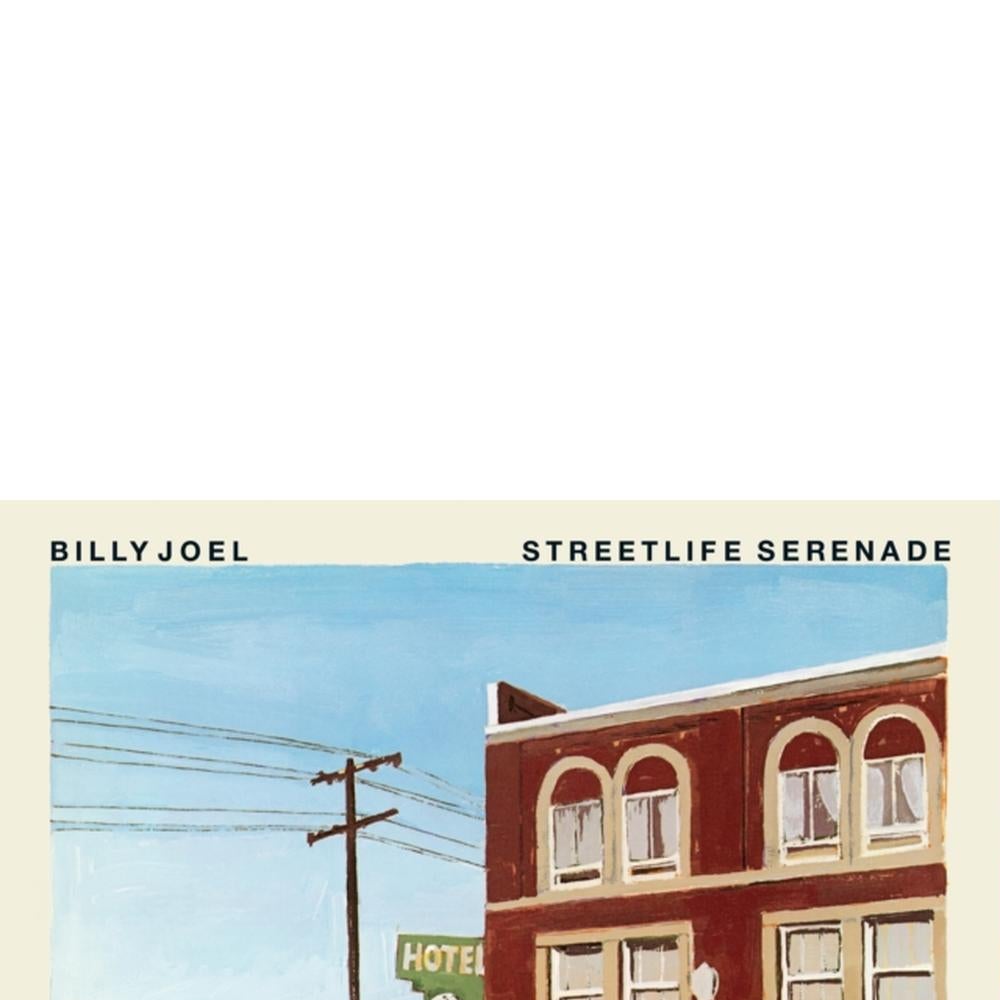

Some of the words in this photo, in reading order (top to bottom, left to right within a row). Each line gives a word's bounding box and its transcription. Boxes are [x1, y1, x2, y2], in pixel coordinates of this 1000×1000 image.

[51, 540, 148, 562] BILLY
[157, 540, 248, 562] JOEL
[522, 540, 741, 562] STREETLIFE
[757, 540, 951, 562] SERENADE
[402, 942, 485, 976] HOTEL
